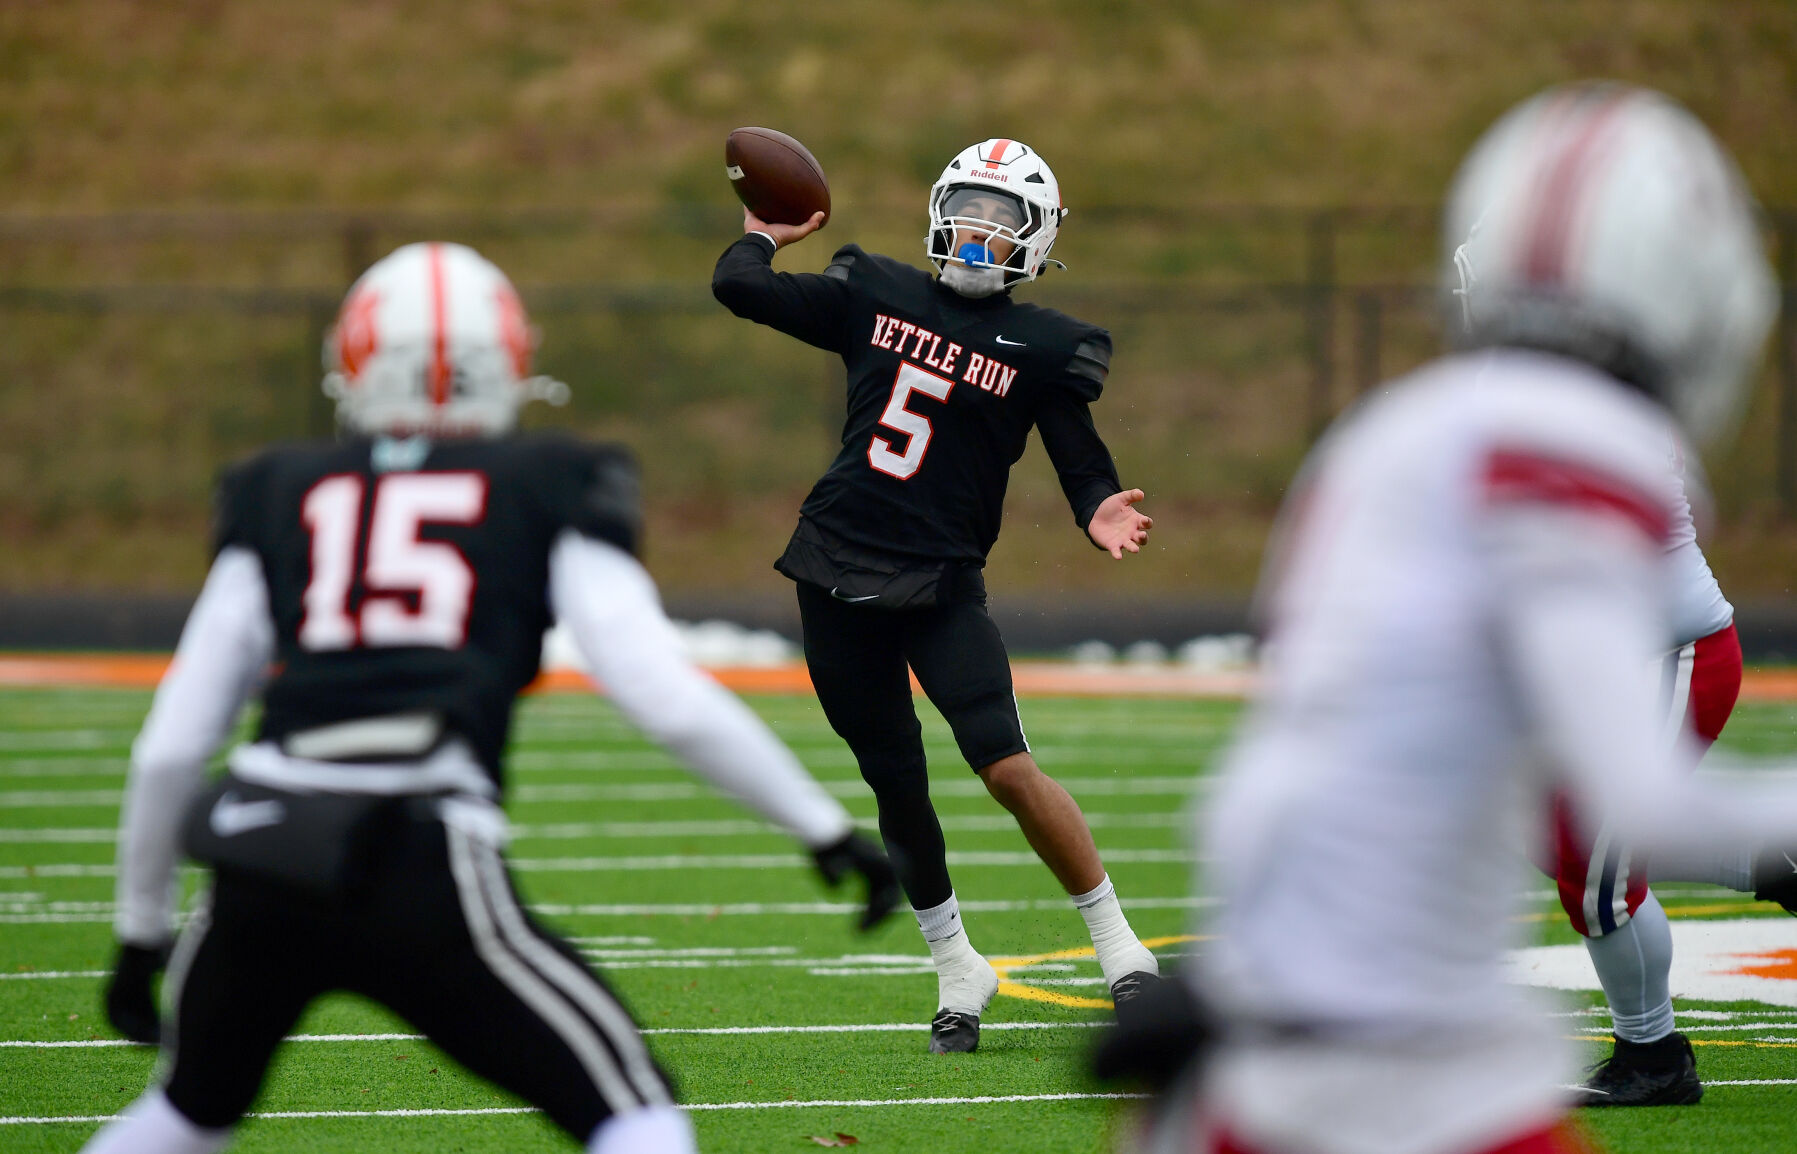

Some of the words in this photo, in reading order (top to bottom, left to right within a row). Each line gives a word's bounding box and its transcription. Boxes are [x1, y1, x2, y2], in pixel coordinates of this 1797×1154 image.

[970, 169, 1009, 183] Riddell
[871, 314, 963, 374] KETTLE
[962, 352, 1018, 398] RUN
[867, 359, 956, 481] 5
[299, 470, 489, 650] 15
